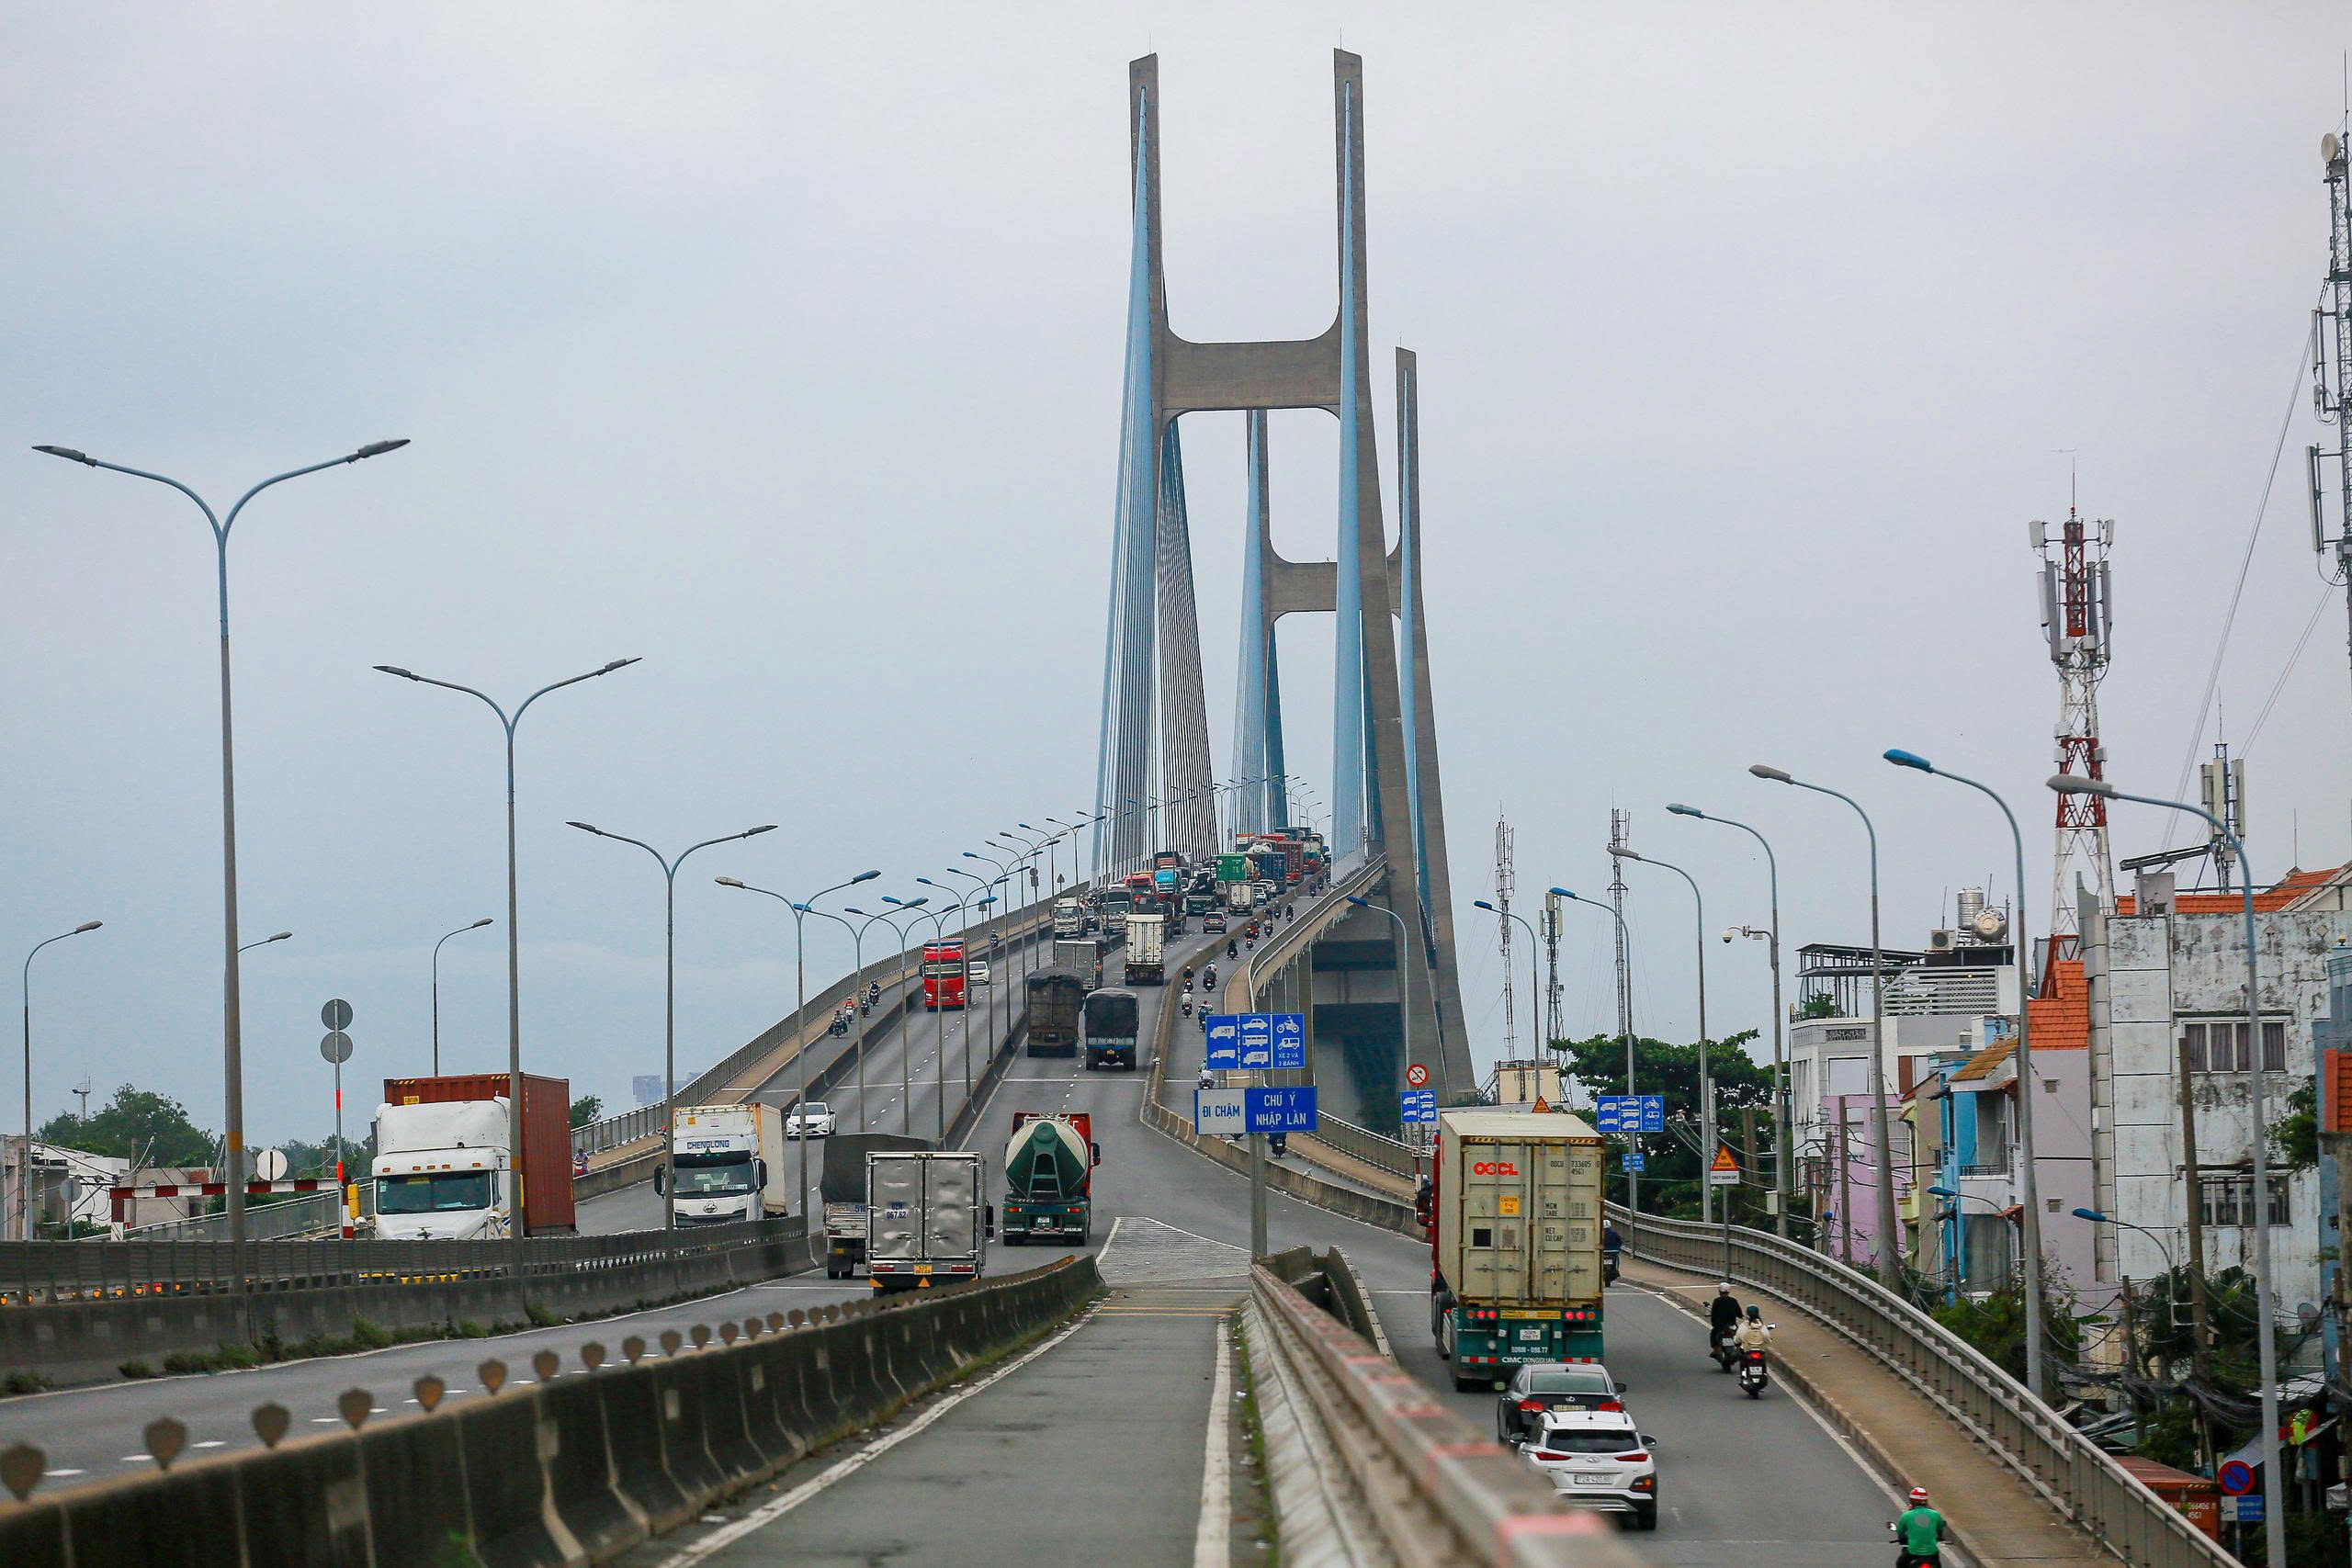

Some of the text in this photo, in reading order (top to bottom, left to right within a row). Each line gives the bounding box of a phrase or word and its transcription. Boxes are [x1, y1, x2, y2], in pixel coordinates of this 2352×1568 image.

[1263, 1090, 1296, 1107] CHÚ Ý
[1203, 1103, 1240, 1119] ĐI CHẬM
[1256, 1110, 1306, 1128] NHẬP LÀN
[686, 1140, 730, 1150] CHENGLONG
[1474, 1161, 1520, 1176] OOCL
[1570, 1160, 1592, 1168] 733605
